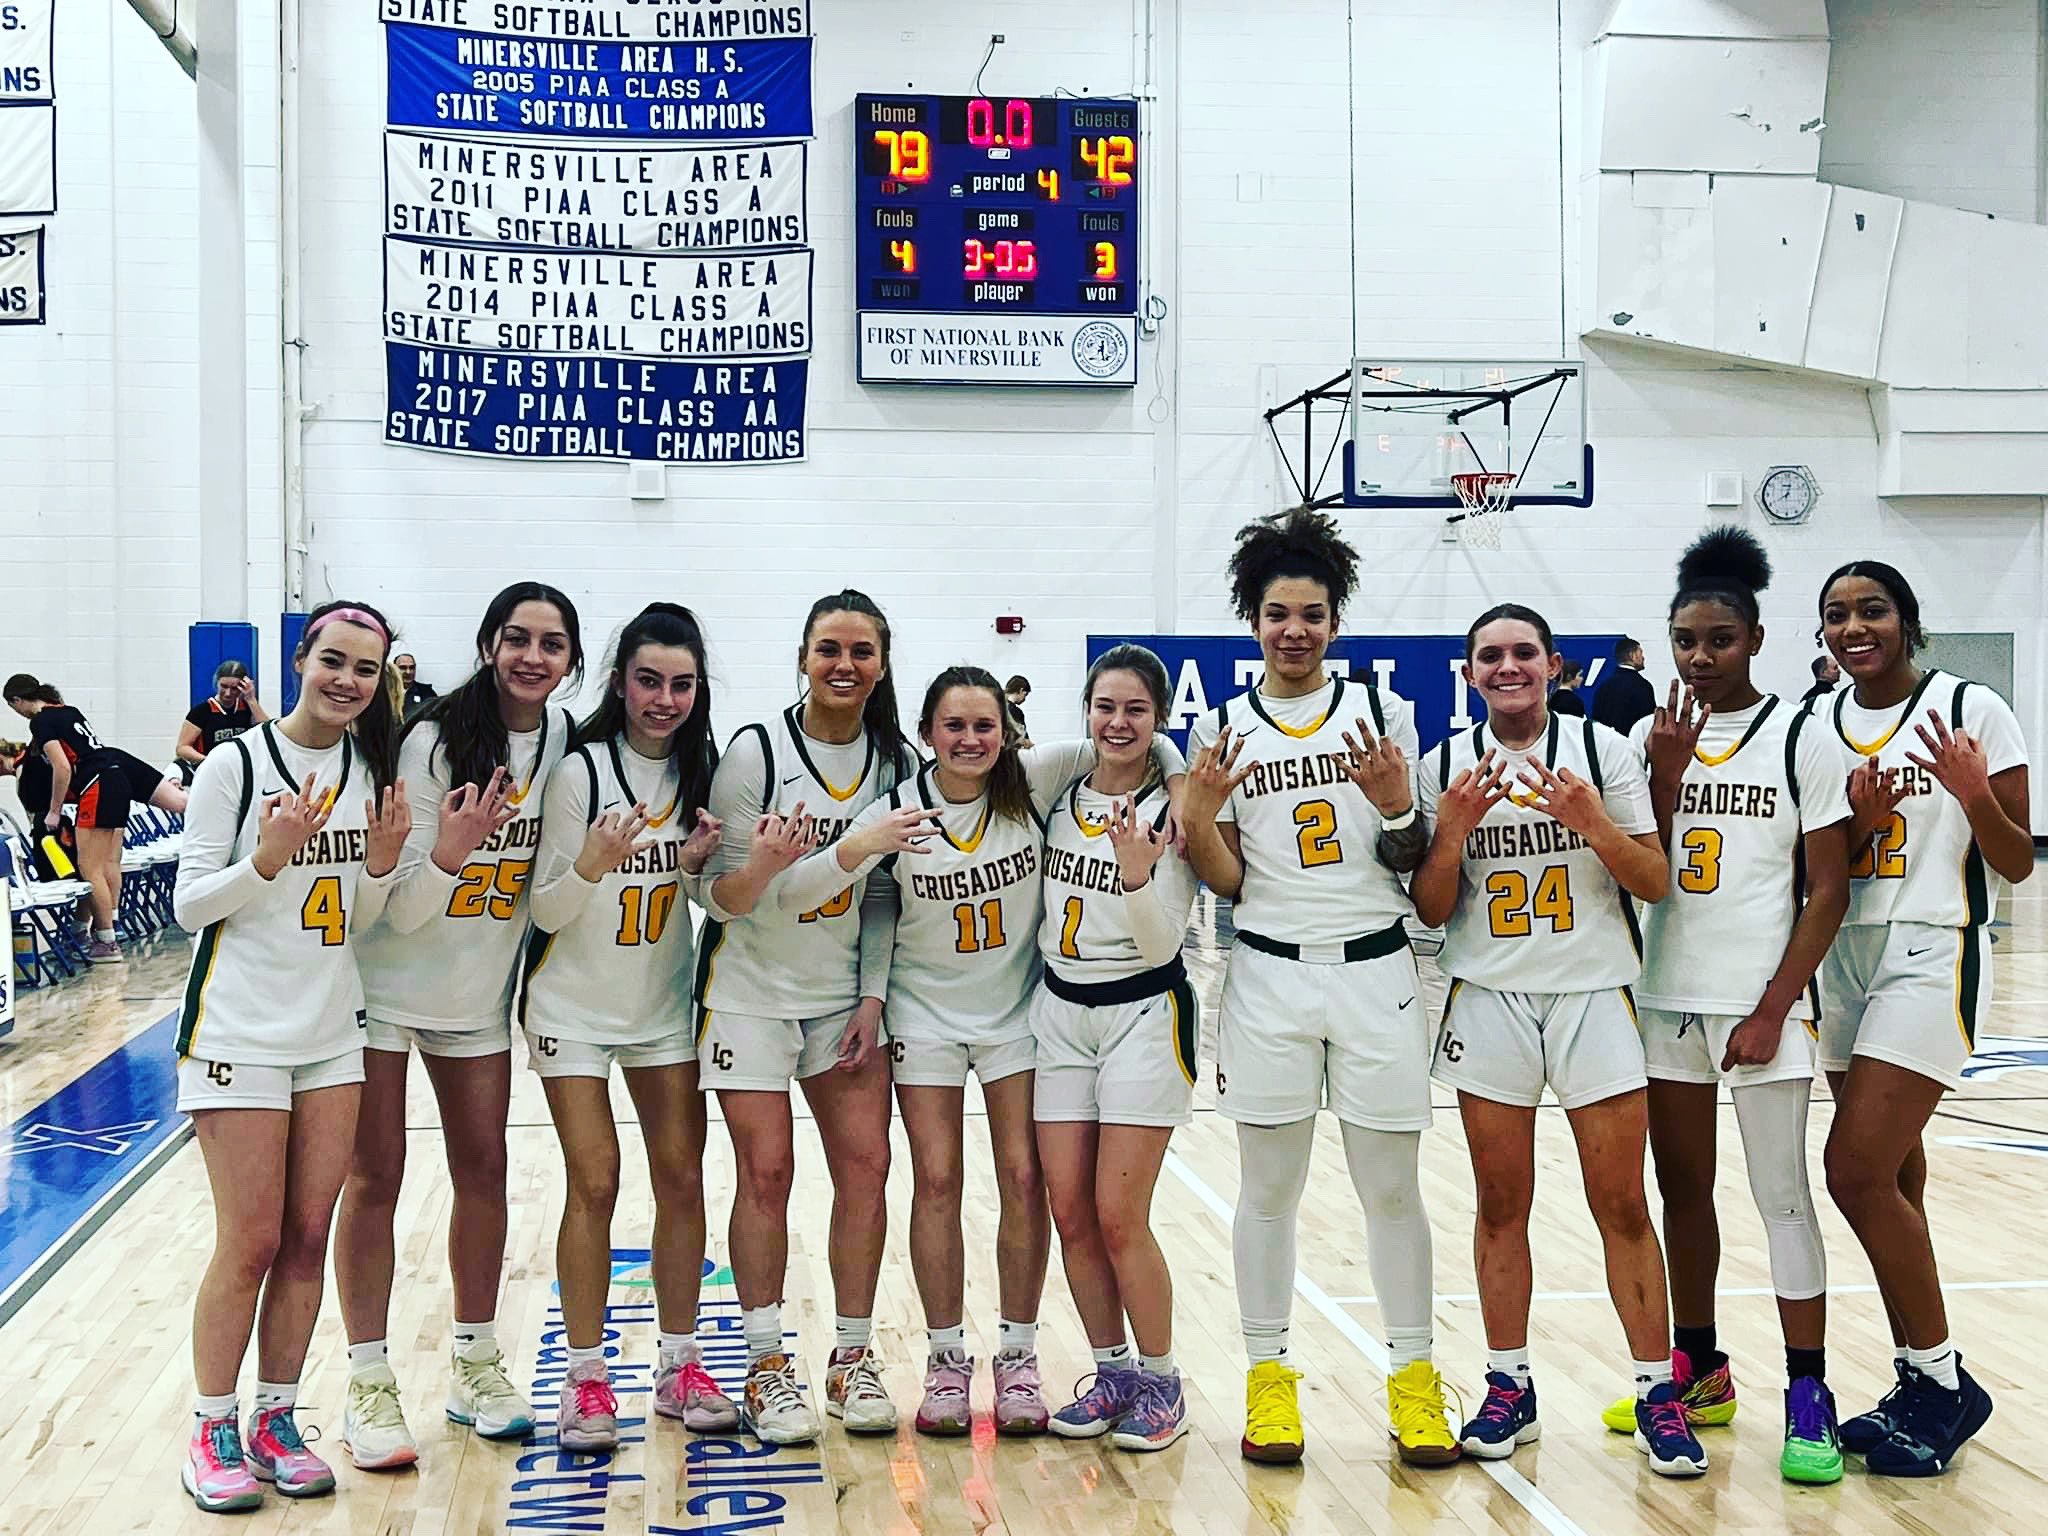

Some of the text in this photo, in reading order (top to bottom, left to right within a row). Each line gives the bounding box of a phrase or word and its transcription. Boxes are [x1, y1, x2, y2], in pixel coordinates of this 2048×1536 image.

[388, 0, 802, 38] STATE SOFTBALL CHAMPIONS
[458, 37, 599, 72] MINERSVILLE
[620, 48, 674, 74] AREA
[473, 71, 729, 99] 2005 PIAA CLASS A
[436, 93, 766, 130] STATE SOFTBALL CHAMPIONS
[872, 103, 916, 123] Home
[967, 99, 1032, 146] 0.0
[1075, 108, 1129, 129] Guests
[419, 142, 773, 183] MINERSVILLE AREA
[875, 130, 931, 178] 79
[1080, 136, 1134, 183] 42
[430, 177, 762, 217] 2011 PIAA CLASS A
[973, 173, 1025, 194] period
[1038, 169, 1059, 201] 4
[394, 205, 799, 249] STATE SOFTBALL CHAMPIONS
[876, 208, 913, 228] fouls
[979, 213, 1019, 231] game
[1083, 213, 1119, 231] fouls
[420, 249, 778, 288] MINERSVILLE AREA
[891, 240, 915, 272] 4
[1094, 242, 1116, 277] 3
[427, 283, 770, 321] 2014 PIAA CLASS A
[975, 282, 1023, 303] player
[1085, 286, 1116, 301] won
[391, 312, 804, 353] STATE SOFTBALL CHAMPIONS
[867, 327, 1065, 348] FIRST NATIONAL BANK
[418, 351, 776, 394] MINERSVILLE AREA
[890, 348, 1041, 367] OF MINERSVILLE
[415, 384, 778, 427] 2017 PIAA CLASS AA
[390, 412, 800, 459] STATE SOFTBALL CHAMPIONS
[1293, 799, 1343, 869] 2
[912, 845, 1036, 900] CRUSADERS
[1678, 827, 1723, 894] 3
[446, 858, 530, 920] 25
[1486, 864, 1573, 938] 24
[301, 876, 346, 946] 4
[616, 880, 678, 946] 10
[953, 898, 1006, 953] 11
[1060, 895, 1083, 959] 1
[538, 1035, 558, 1056] LC
[712, 1042, 733, 1071] LC
[1443, 1031, 1464, 1062] LC
[207, 1060, 232, 1086] LC
[648, 1424, 823, 1536] alley
